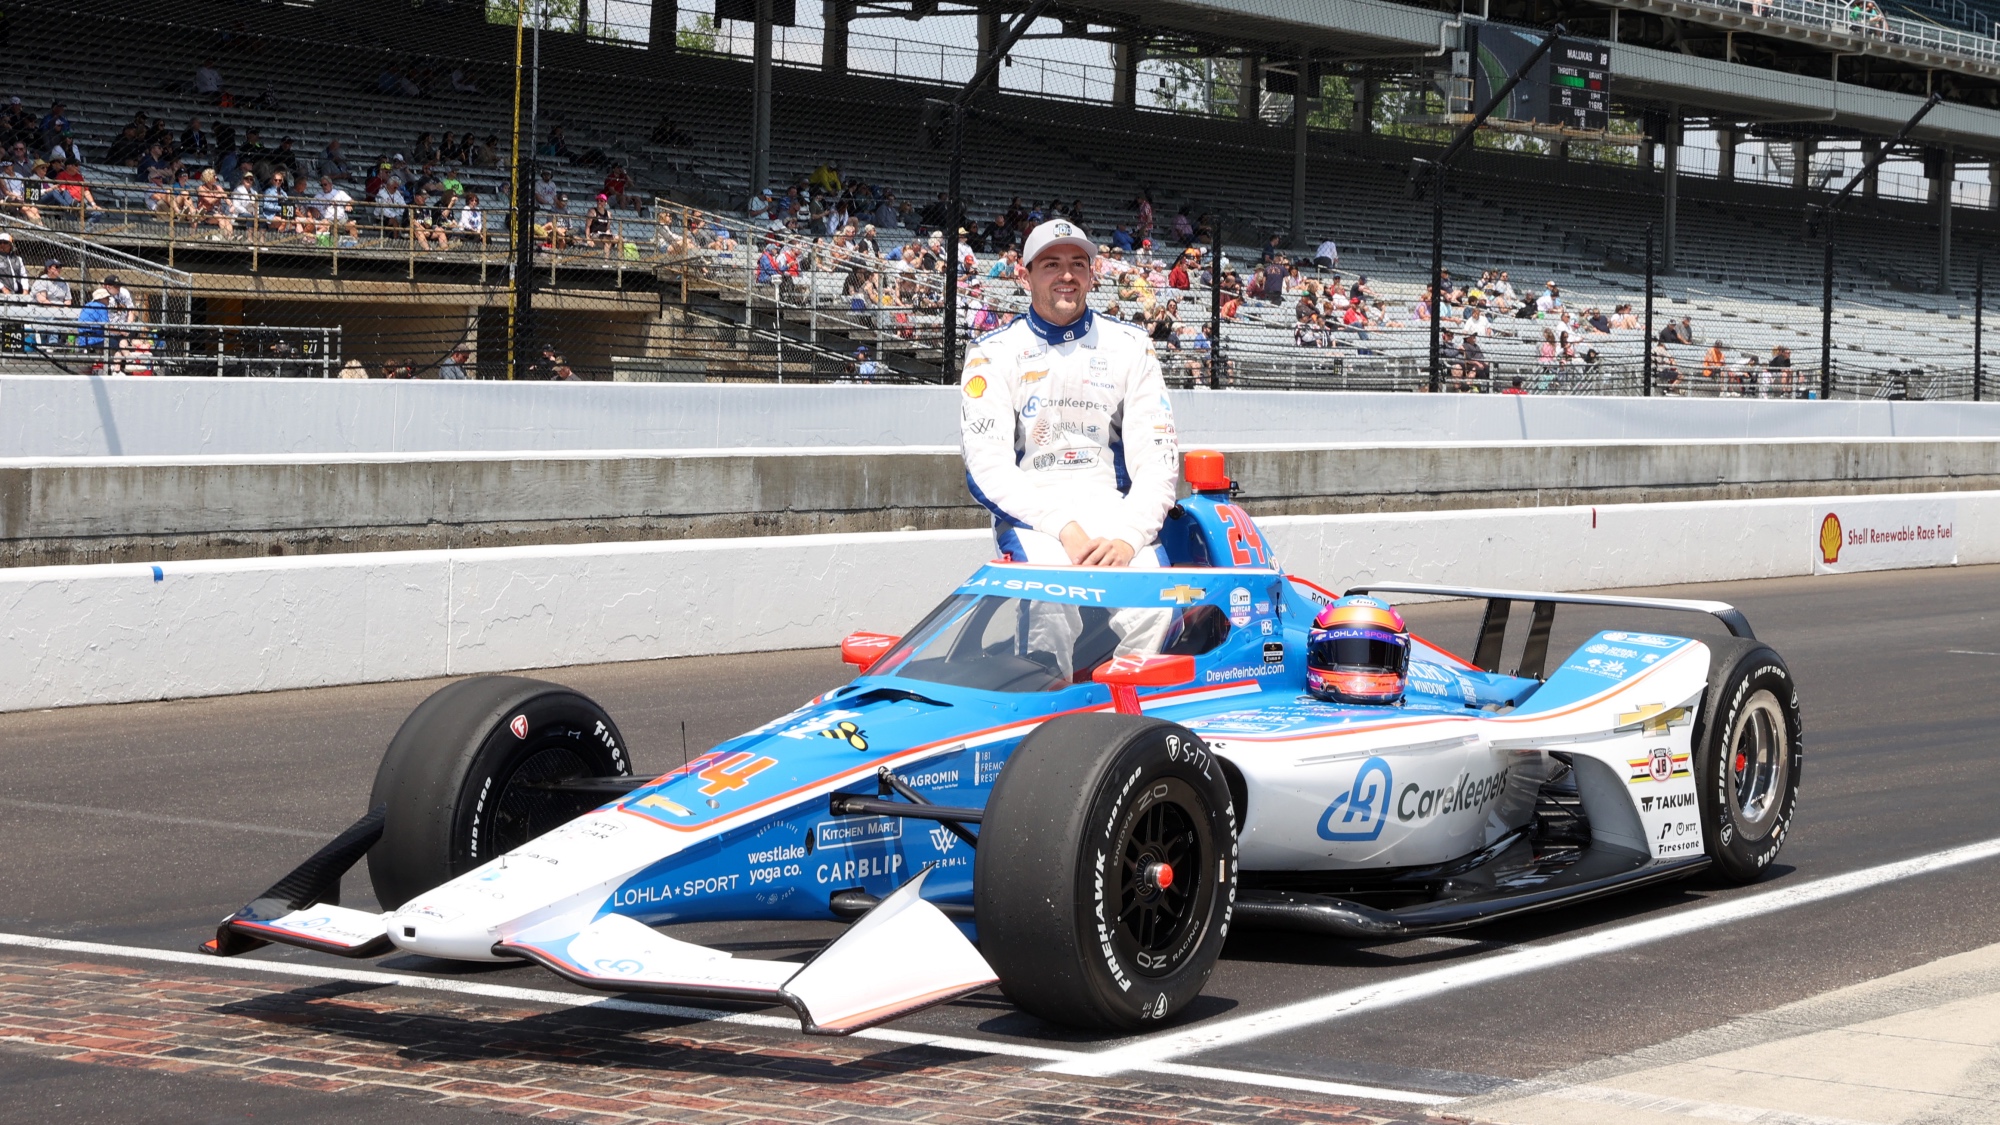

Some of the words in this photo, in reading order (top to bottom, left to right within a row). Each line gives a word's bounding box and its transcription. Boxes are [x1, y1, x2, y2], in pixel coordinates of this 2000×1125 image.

[1213, 504, 1266, 566] 24
[1848, 528, 1868, 546] Shell
[1870, 525, 1915, 544] Renewable
[1917, 525, 1935, 540] Race
[1937, 522, 1953, 539] Fuel
[1004, 579, 1106, 602] SPORT
[1329, 630, 1359, 639] LOHLA
[1364, 631, 1393, 641] SPORT
[1206, 663, 1285, 682] DreyerReinbold.com
[1412, 680, 1448, 697] WINDOWS
[1718, 673, 1750, 805] FIREHAWK
[981, 751, 991, 761] 181
[980, 761, 1005, 773] FREMO
[909, 770, 959, 788] AGROMIN
[1397, 768, 1509, 824] CareKeepers
[1656, 792, 1696, 810] TAKUMI
[822, 826, 864, 841] KITCHEN
[867, 822, 895, 835] MART
[1685, 823, 1697, 832] NTT
[748, 844, 805, 864] westlake
[1658, 840, 1700, 855] Firestone
[750, 865, 781, 886] yoga
[784, 863, 802, 877] co.
[816, 854, 903, 884] CARBLIP
[1219, 800, 1239, 938] Firestone
[614, 884, 673, 907] LOHLA
[683, 874, 740, 897] SPORT
[1094, 848, 1133, 993] FIREHAWK
[1172, 919, 1200, 962] RACING
